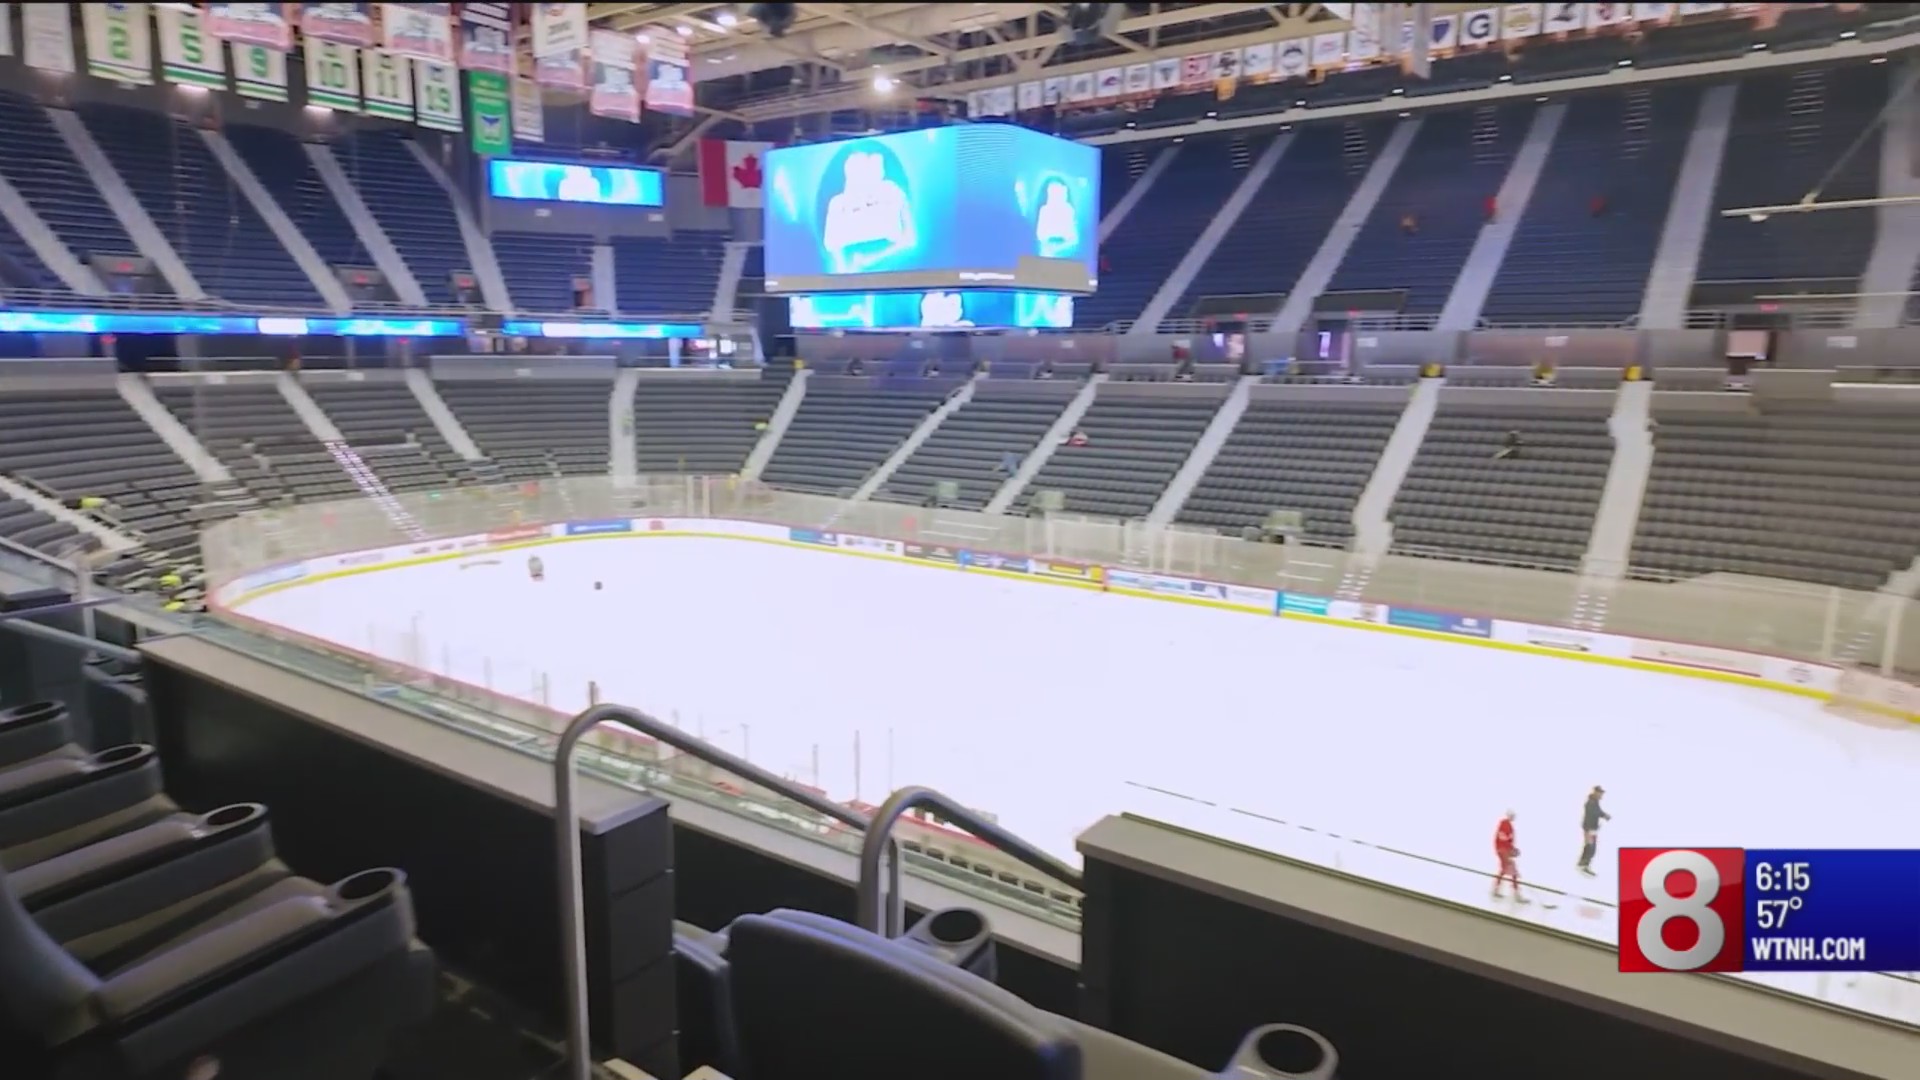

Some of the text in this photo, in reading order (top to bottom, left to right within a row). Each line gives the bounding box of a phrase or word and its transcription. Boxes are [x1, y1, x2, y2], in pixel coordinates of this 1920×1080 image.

[1469, 14, 1489, 39] G
[108, 24, 129, 60] 2
[181, 25, 203, 63] 5
[250, 47, 268, 77] 9
[319, 60, 345, 87] 10
[377, 71, 399, 98] 11
[425, 85, 451, 112] 19
